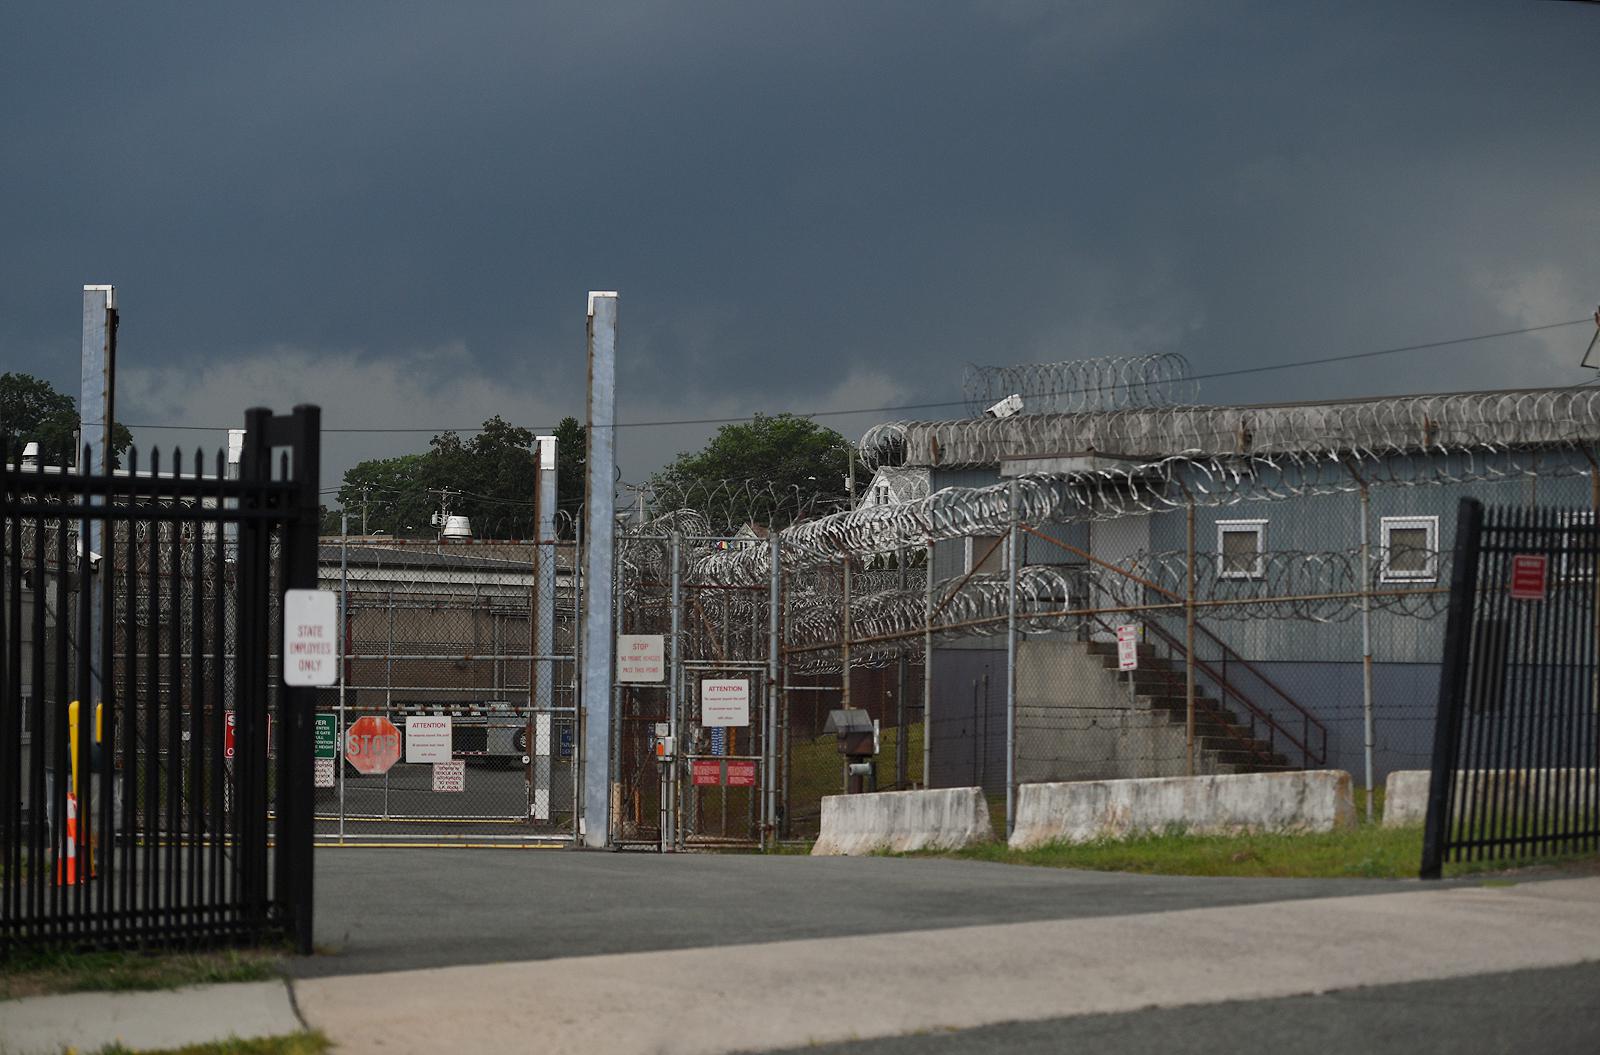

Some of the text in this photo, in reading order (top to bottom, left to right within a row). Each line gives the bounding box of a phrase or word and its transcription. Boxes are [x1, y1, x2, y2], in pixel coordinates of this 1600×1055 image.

[298, 624, 323, 638] STATE
[289, 642, 331, 655] EMPLOYEES
[298, 659, 322, 672] ONLY
[350, 735, 397, 756] STOP
